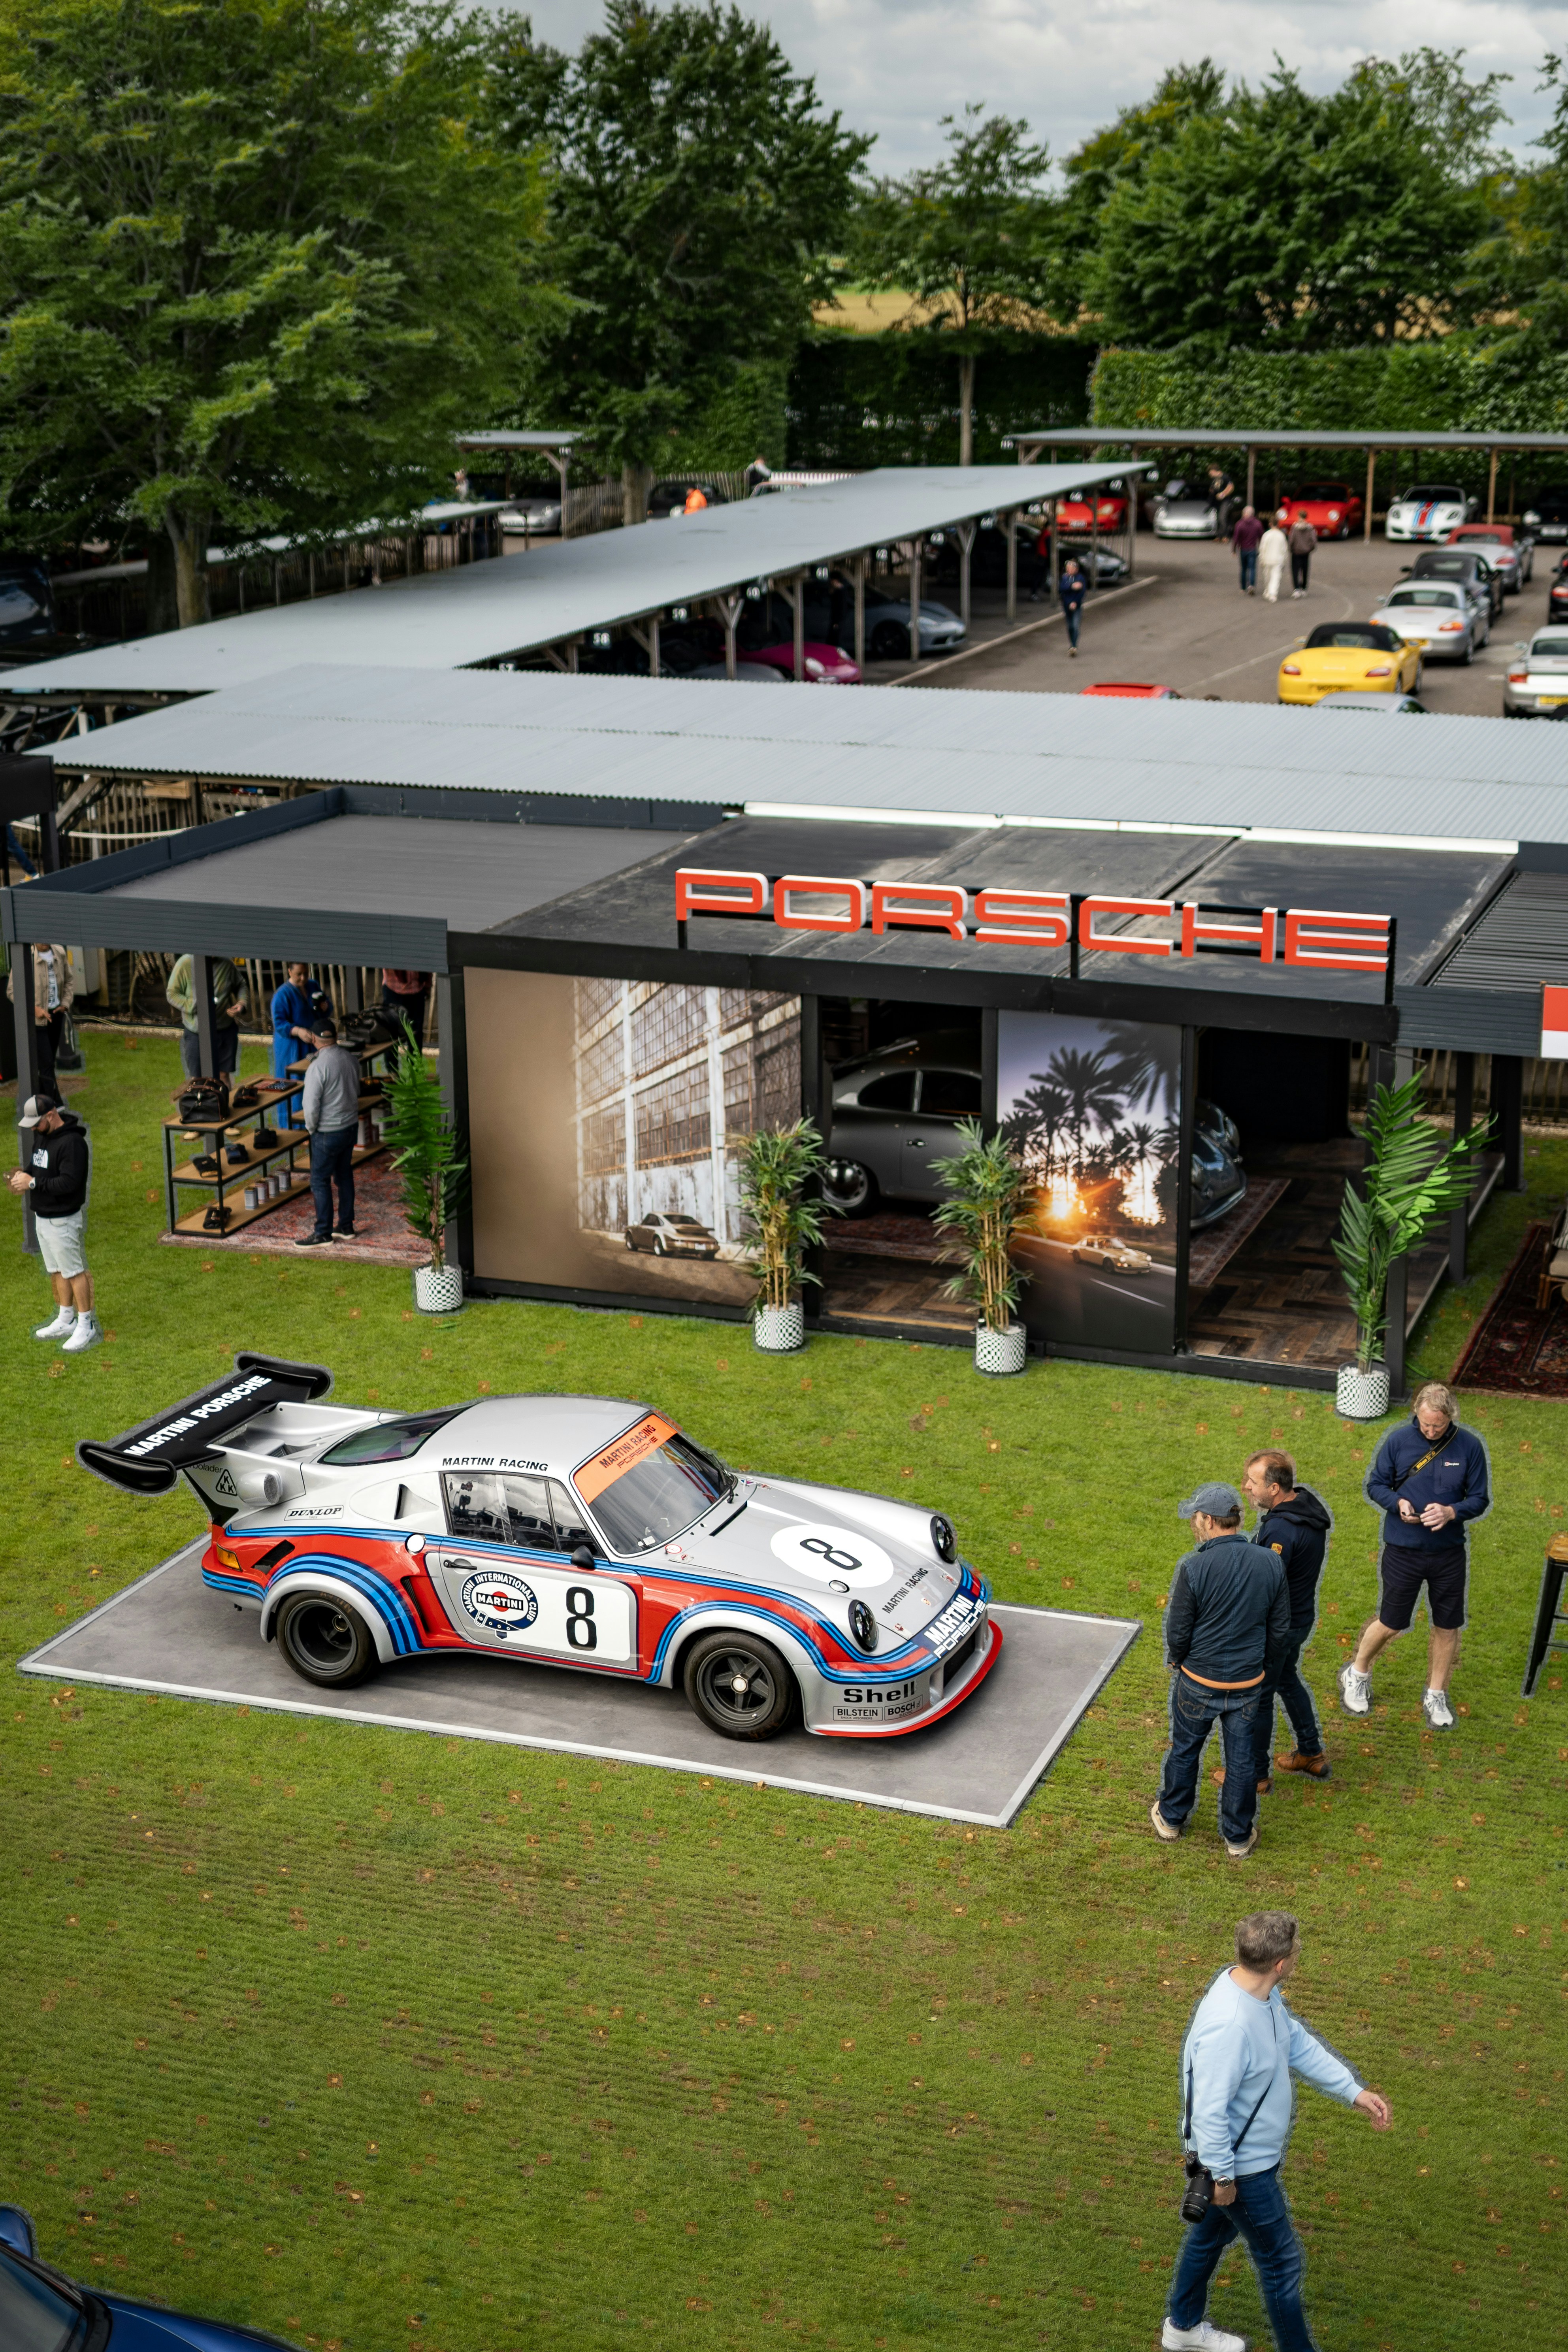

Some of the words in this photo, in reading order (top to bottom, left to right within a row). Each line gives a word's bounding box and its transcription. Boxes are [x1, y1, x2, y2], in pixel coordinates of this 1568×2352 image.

[593, 632, 611, 646] 58
[675, 868, 1391, 971] PORSCHE
[123, 1417, 199, 1456] MARTINI
[190, 1376, 272, 1418] PORSCHE
[599, 1442, 634, 1468] MARTINI
[630, 1425, 656, 1446] RACING
[617, 1436, 658, 1468] PORSCHE
[190, 1463, 223, 1473] bolader
[442, 1457, 494, 1466] MARTINI
[499, 1459, 548, 1471] RACING
[288, 1508, 342, 1517] DUNLOP
[800, 1538, 862, 1570] 8
[463, 1580, 475, 1613] MARTINI
[474, 1573, 533, 1601] INTERNATIONAL
[526, 1602, 536, 1621] CLUB
[478, 1594, 522, 1609] MARTINI
[882, 1587, 910, 1613] MARTINI
[905, 1568, 929, 1589] RACING
[566, 1587, 597, 1651] 8
[924, 1594, 974, 1645] MARTINI
[933, 1599, 986, 1658] PORSCHE
[844, 1681, 914, 1703] Shell
[888, 1702, 915, 1715] BOSCH
